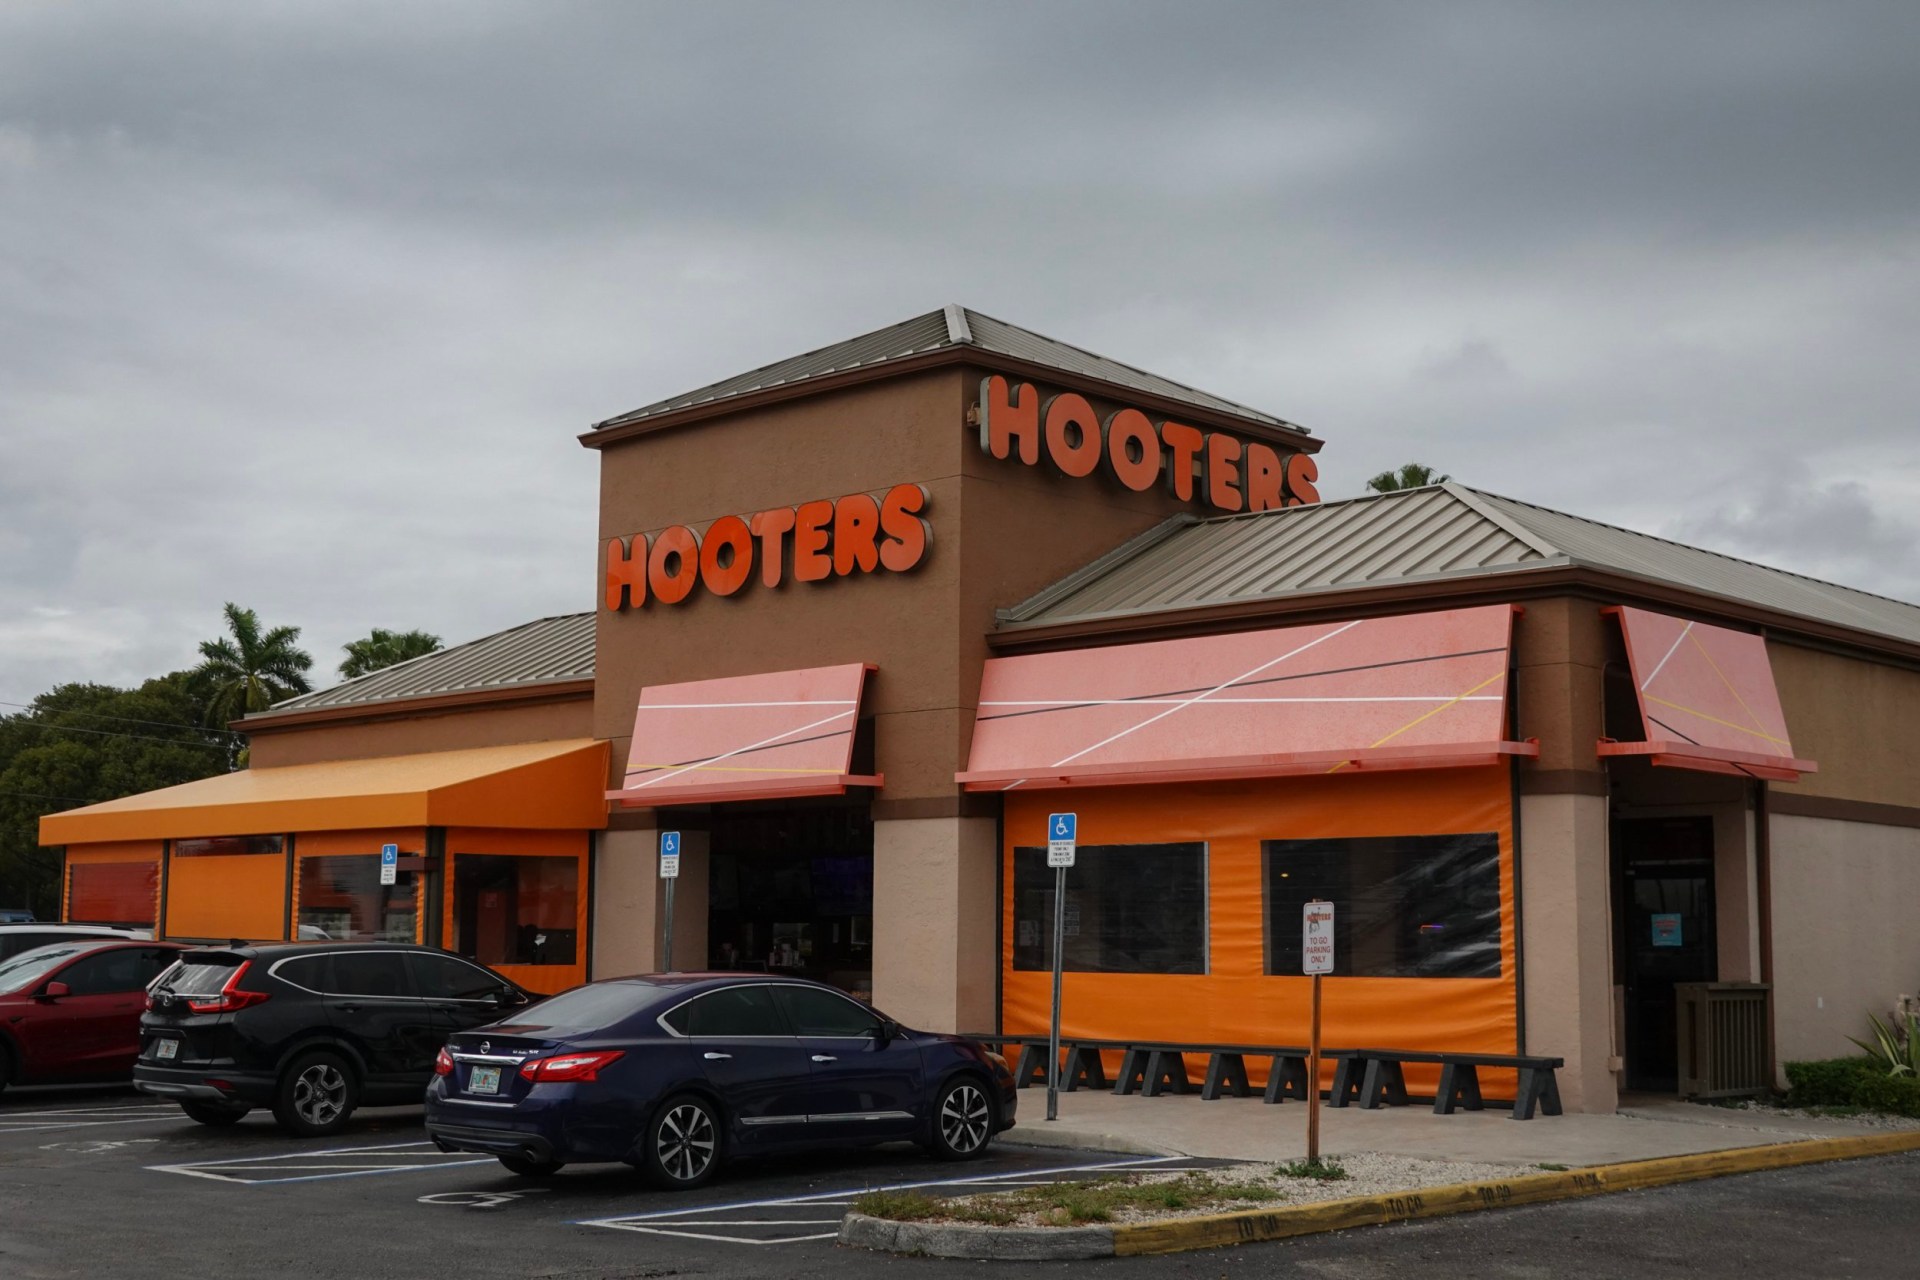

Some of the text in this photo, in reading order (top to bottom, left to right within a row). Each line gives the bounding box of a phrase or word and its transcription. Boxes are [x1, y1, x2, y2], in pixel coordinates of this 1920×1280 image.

[981, 375, 1321, 513] HOOTERS
[604, 483, 930, 612] HOOTERS
[1319, 936, 1328, 944] GO
[1306, 946, 1330, 954] PARKING
[1311, 956, 1326, 964] ONLY
[1477, 1184, 1511, 1204] TO GO
[1387, 1198, 1405, 1215] TO
[1236, 1216, 1254, 1239] TO
